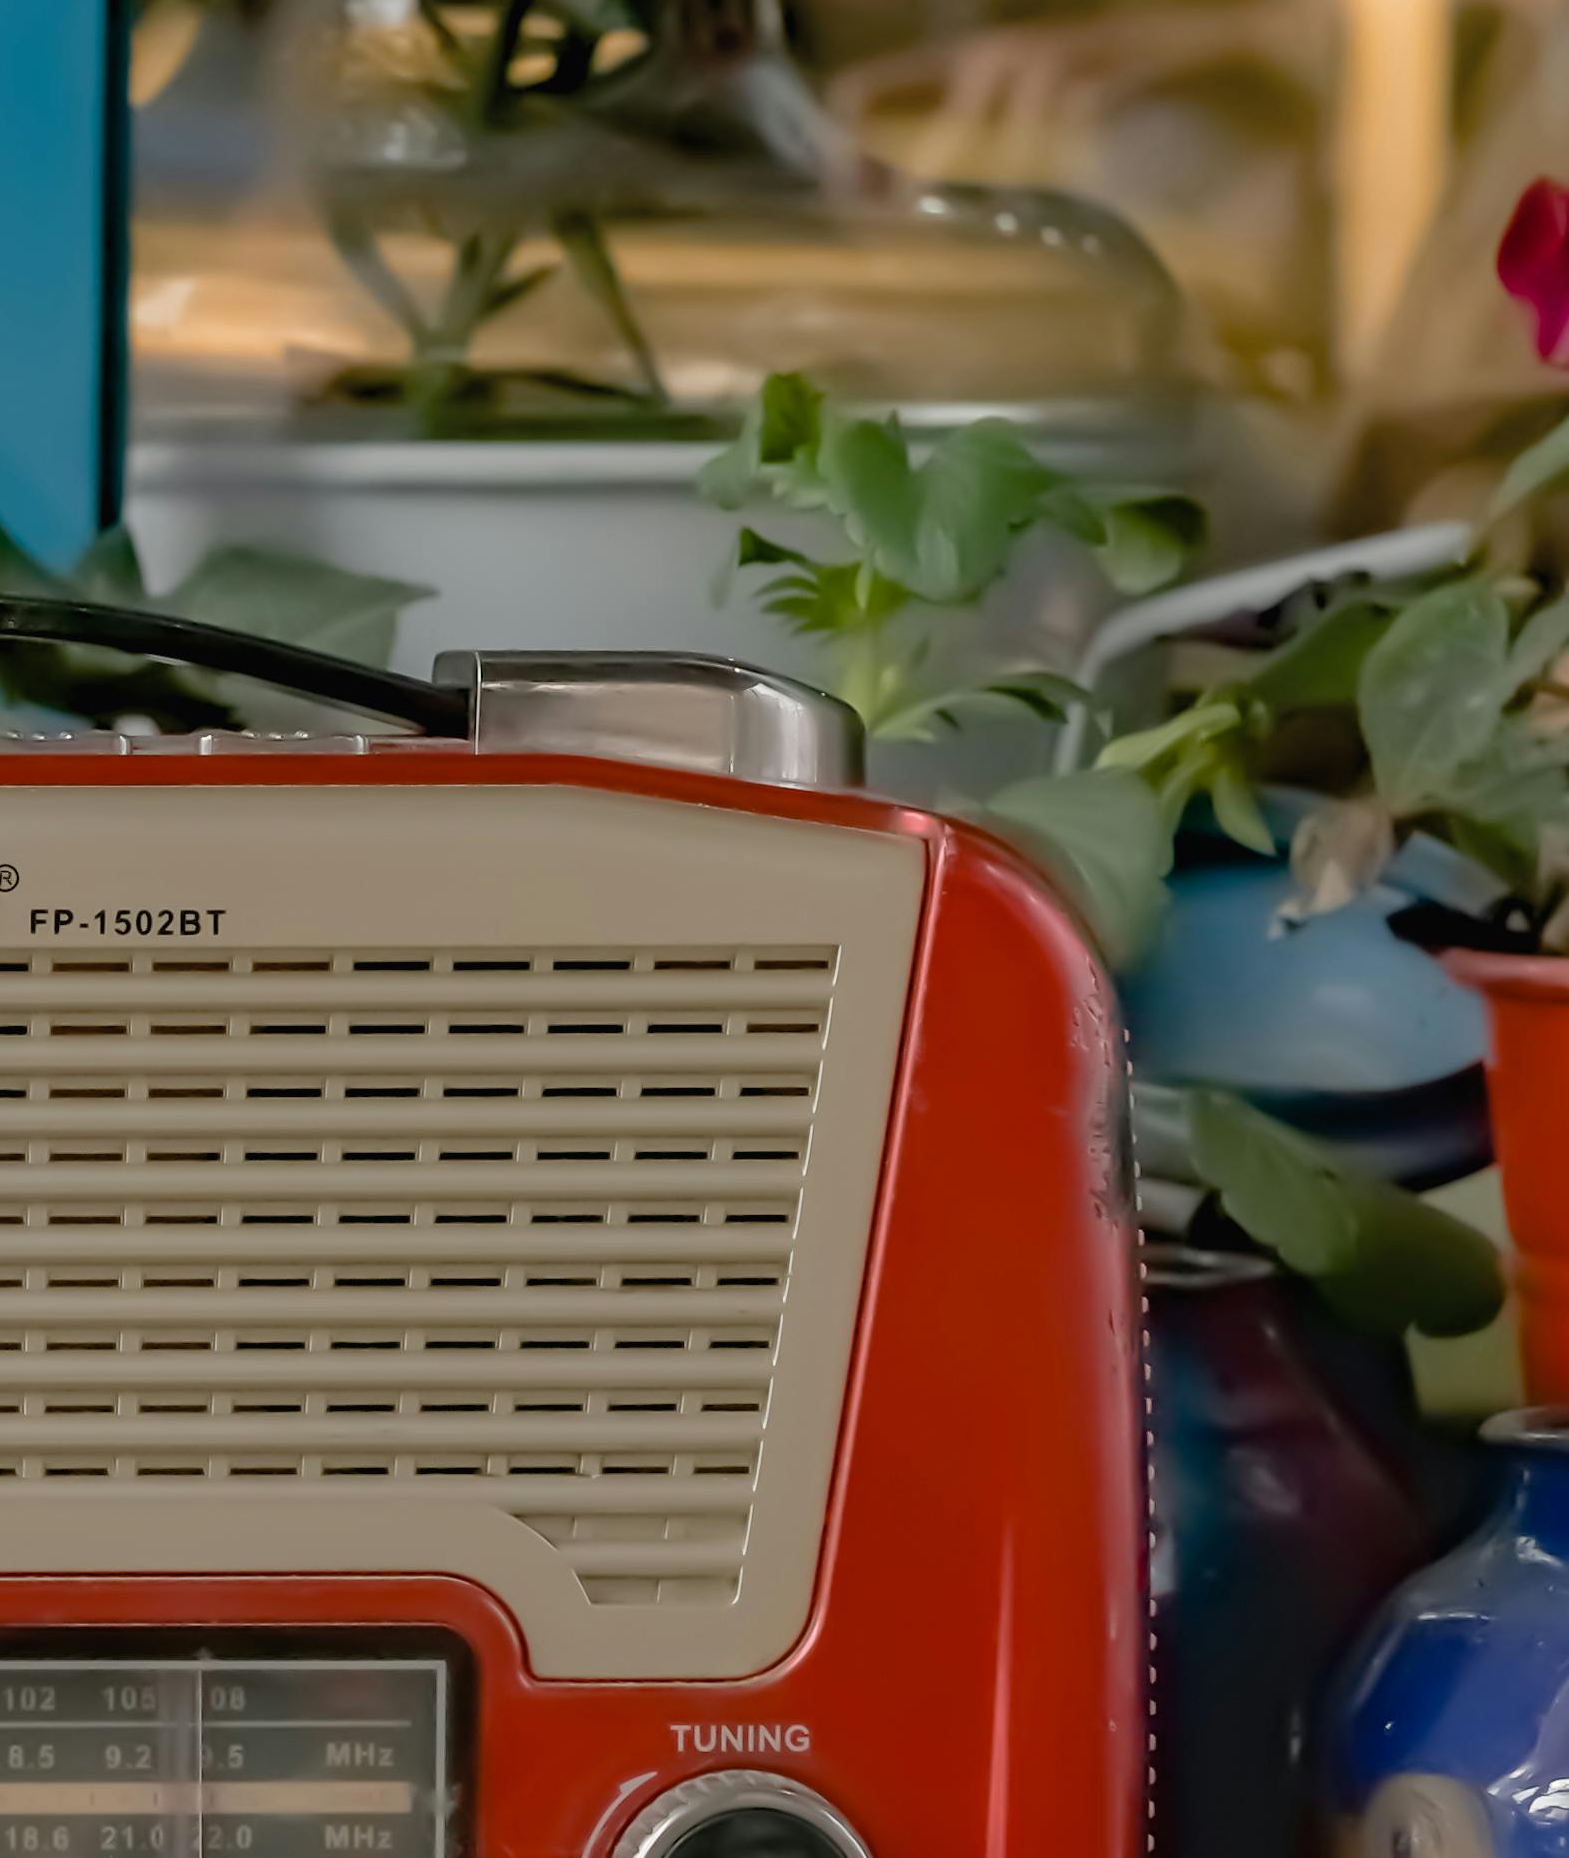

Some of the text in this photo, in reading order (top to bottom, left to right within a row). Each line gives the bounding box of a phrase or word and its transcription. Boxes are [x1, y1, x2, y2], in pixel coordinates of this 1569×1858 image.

[31, 909, 226, 935] FP-1502BT
[2, 1686, 56, 1711] 102
[102, 1686, 157, 1711] 105
[670, 1724, 811, 1752] TUNING
[7, 1745, 55, 1770] 8.5
[104, 1744, 152, 1769] 9.2
[324, 1741, 395, 1768] MHz
[5, 1826, 70, 1850] 18.6
[100, 1825, 164, 1850] 21.0
[324, 1825, 394, 1850] MHz
